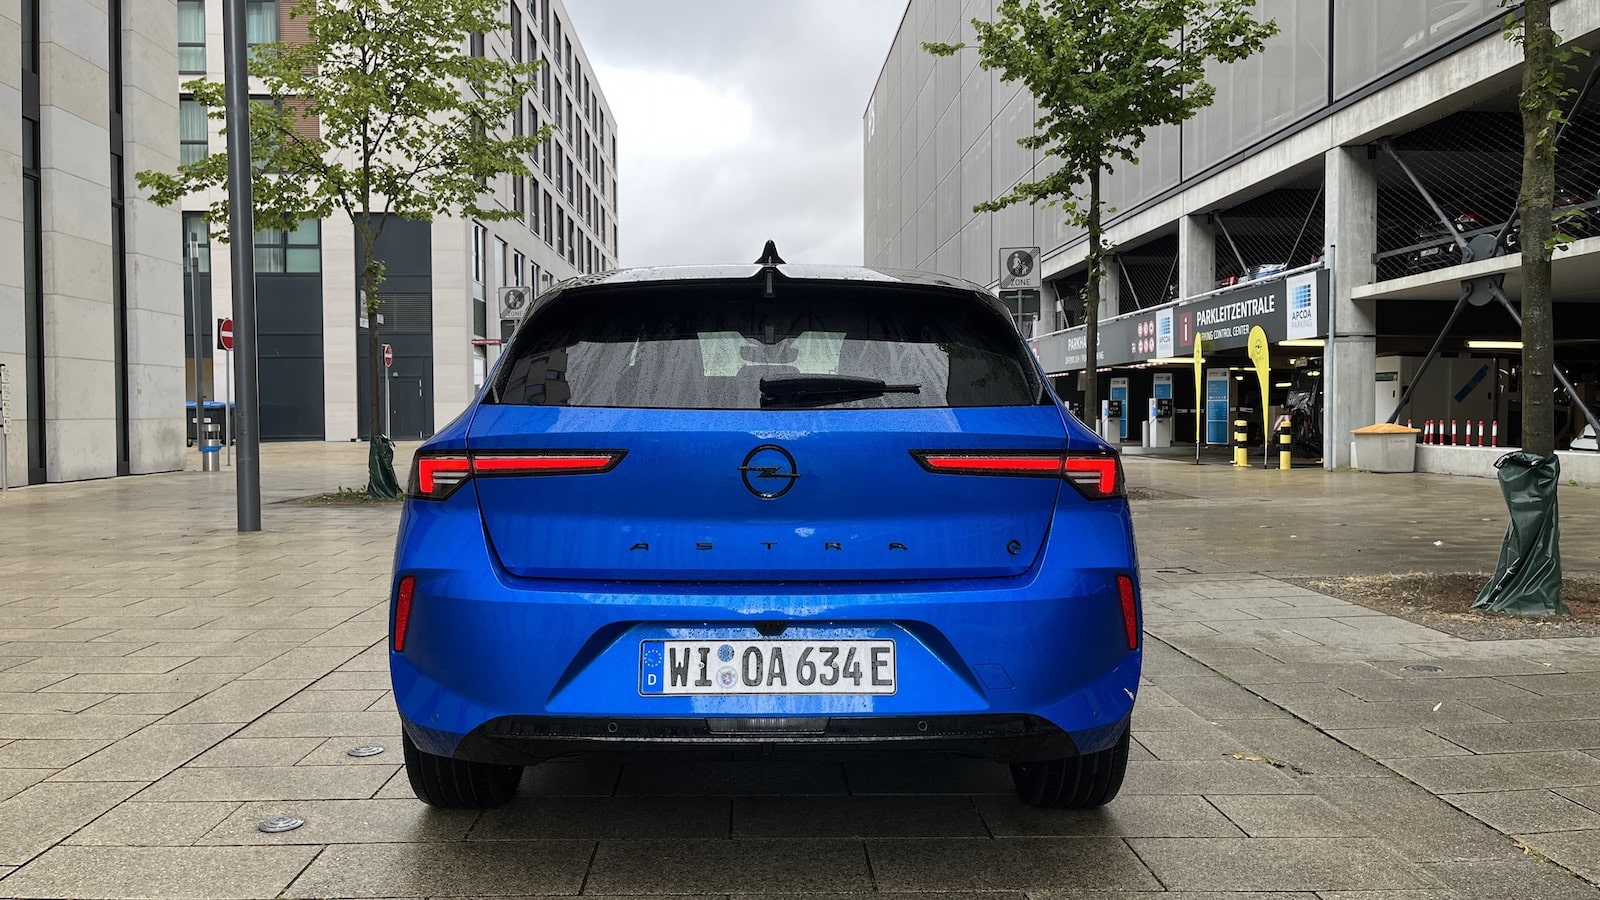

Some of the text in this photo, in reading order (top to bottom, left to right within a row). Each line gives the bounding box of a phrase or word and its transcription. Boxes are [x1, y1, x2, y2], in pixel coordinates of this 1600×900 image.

[1010, 278, 1031, 286] ZONE
[1196, 294, 1275, 327] PARKLEITZENTRALE
[1291, 309, 1312, 321] APCOA
[1232, 324, 1249, 337] CENTER
[1067, 332, 1100, 352] PARKHAS
[629, 541, 908, 551] ASTRA
[669, 647, 712, 687] WI
[741, 646, 787, 687] OA
[647, 674, 657, 685] D
